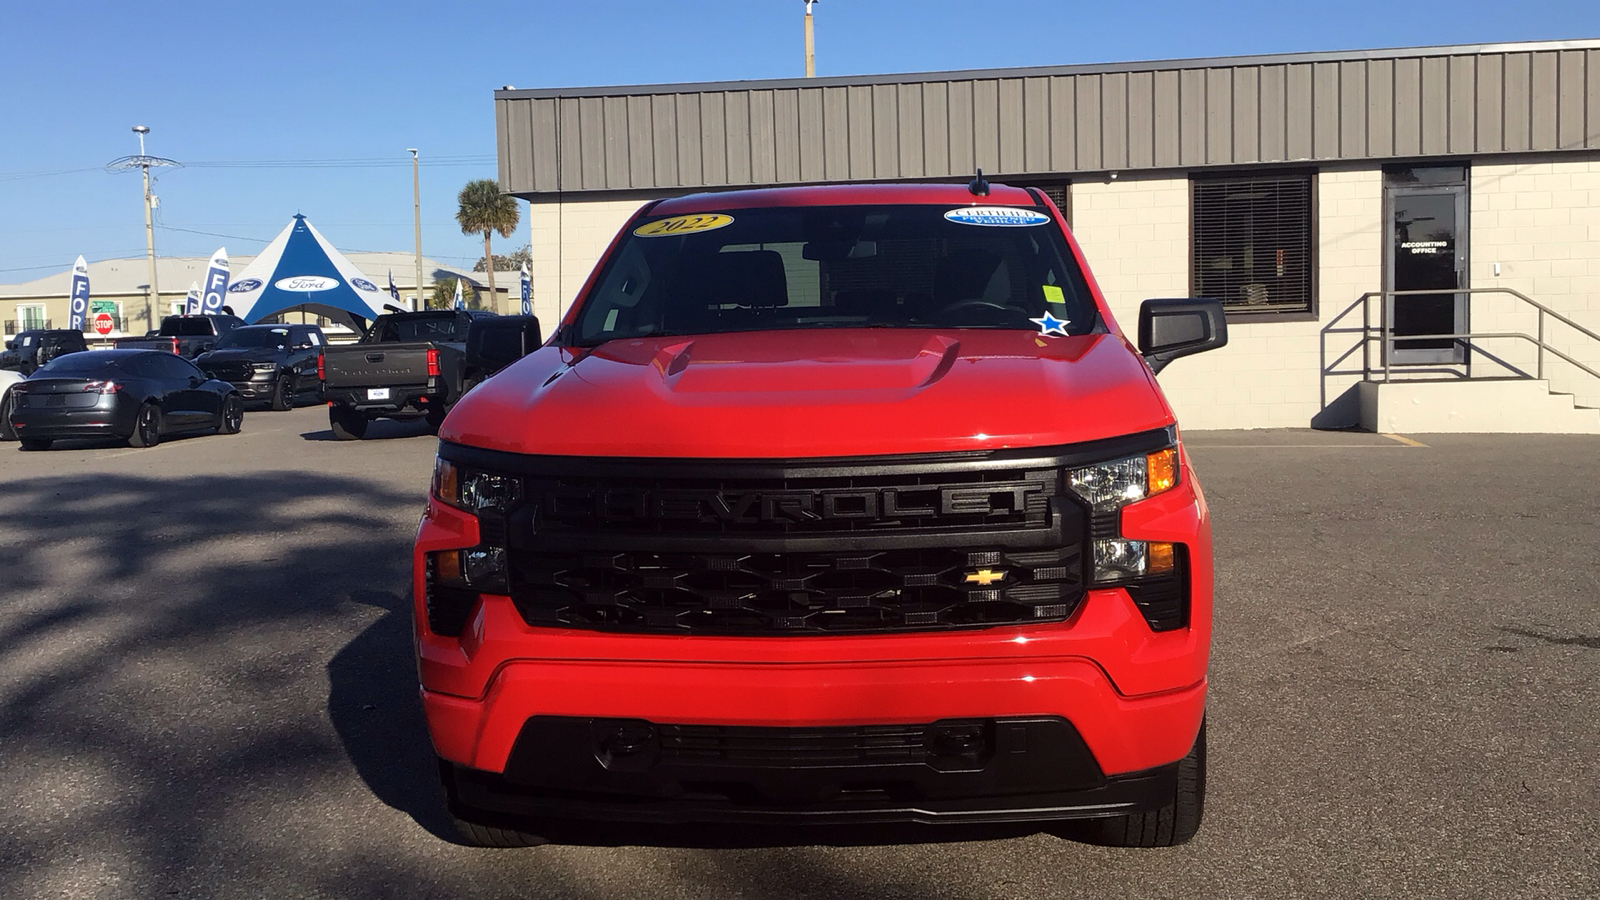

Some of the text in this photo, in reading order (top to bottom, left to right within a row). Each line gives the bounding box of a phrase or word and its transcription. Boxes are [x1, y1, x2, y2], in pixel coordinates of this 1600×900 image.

[648, 216, 719, 234] 2022
[289, 279, 326, 289] Ford
[95, 320, 112, 329] STOP
[545, 479, 1046, 523] CHEVROLET
